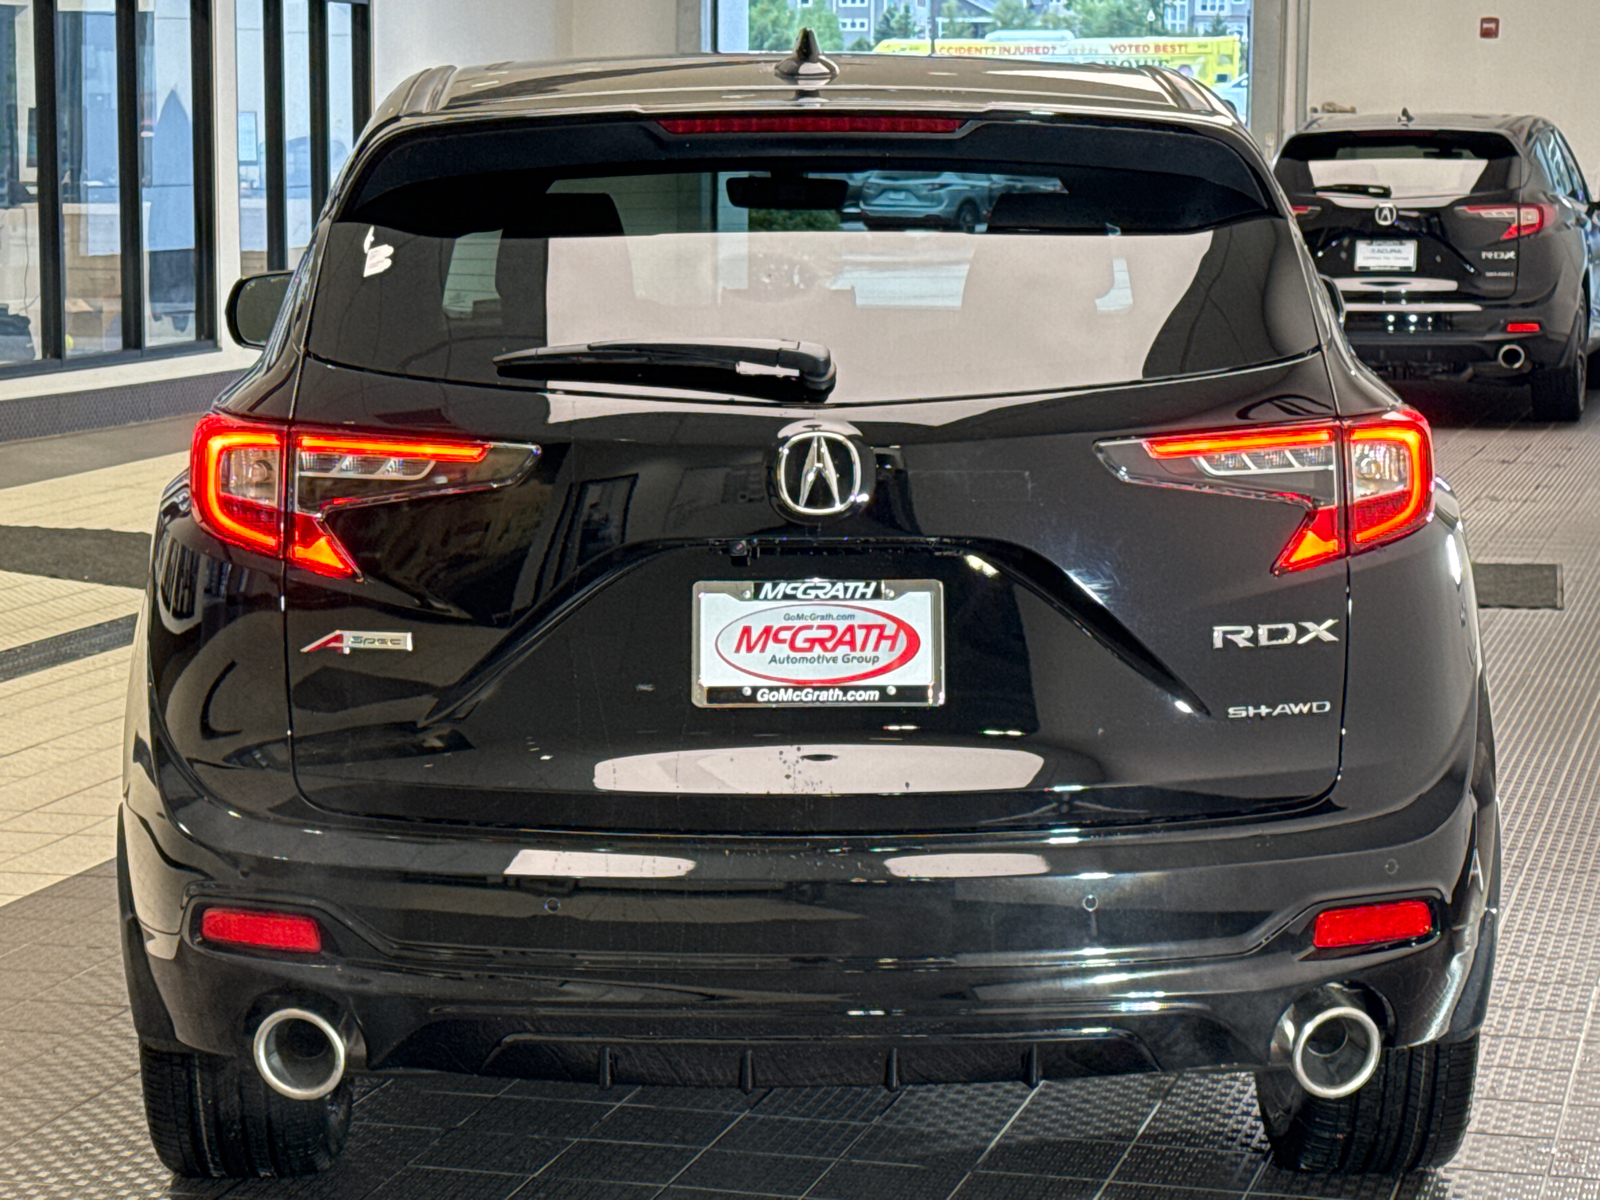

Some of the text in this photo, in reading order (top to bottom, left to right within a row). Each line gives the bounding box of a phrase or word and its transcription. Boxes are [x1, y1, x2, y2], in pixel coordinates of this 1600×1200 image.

[934, 46, 1057, 56] CCIDENT? INJURED?
[1110, 44, 1150, 54] VOTED
[783, 612, 856, 622] GoMcGrath.com
[1212, 619, 1340, 650] RDX
[768, 653, 880, 666] Automotive Group
[756, 687, 880, 702] GoMcGrath.com
